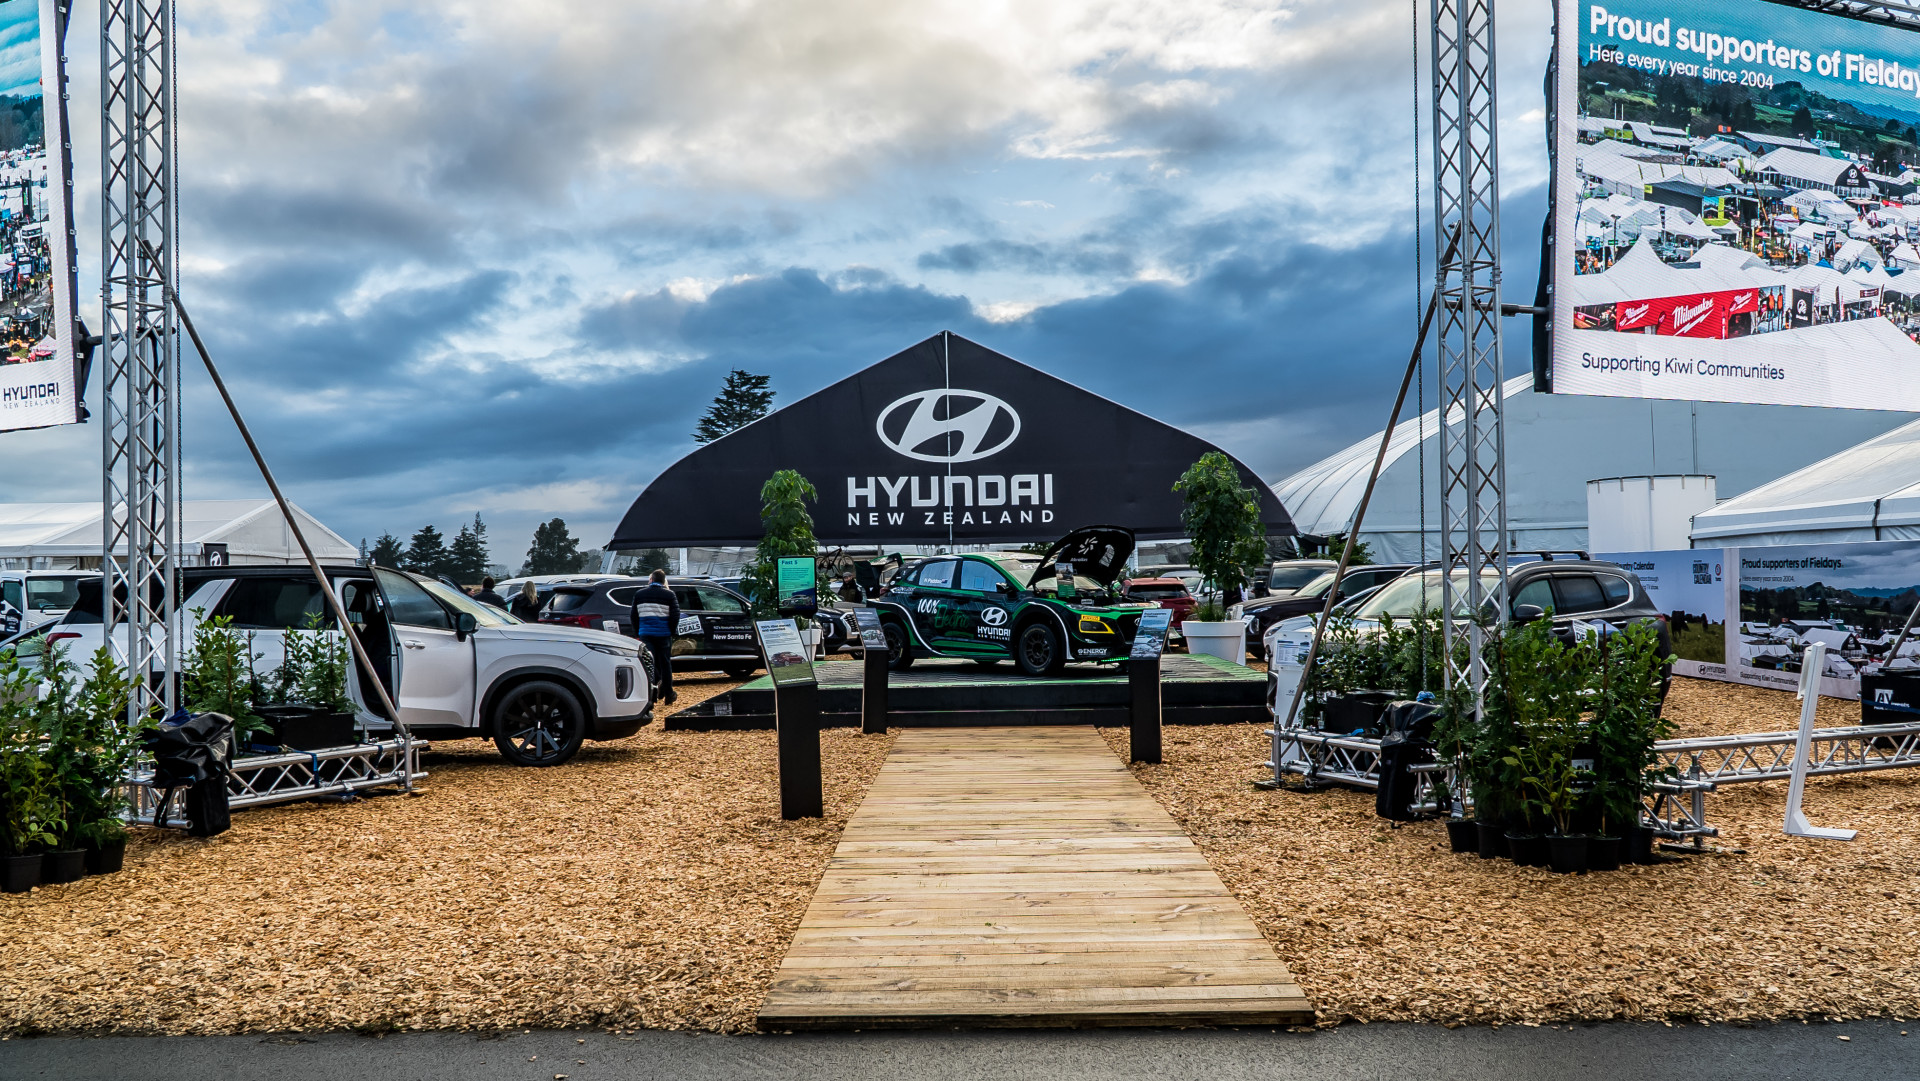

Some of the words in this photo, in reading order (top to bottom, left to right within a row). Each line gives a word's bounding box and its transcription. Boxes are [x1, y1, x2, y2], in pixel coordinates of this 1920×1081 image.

[1590, 5, 1670, 47] Proud
[1676, 27, 1812, 73] supporters
[1816, 50, 1841, 77] of
[1589, 43, 1625, 64] Here
[1627, 53, 1667, 75] every
[1669, 60, 1700, 77] year
[1702, 63, 1737, 84] since
[1740, 69, 1774, 90] 2004
[1672, 297, 1714, 329] Milwaukee
[1581, 352, 1661, 376] Supporting
[1665, 357, 1694, 375] Kiwi
[1697, 359, 1785, 380] Communities
[3, 382, 59, 401] HYUNDAI
[3, 402, 20, 410] NEW
[24, 397, 60, 408] ZEALAND
[847, 474, 1053, 508] HYUNDAI
[848, 513, 905, 526] NEW
[924, 509, 1054, 525] ZEALAND
[1633, 561, 1655, 571] Calendar
[1741, 558, 1761, 569] Proud
[1762, 558, 1800, 571] supporters
[1800, 557, 1809, 569] of
[918, 598, 940, 614] 100%
[678, 623, 701, 634] DEALS
[977, 626, 1011, 637] HYUNDAI
[1740, 671, 1761, 682] Supporting
[1771, 675, 1798, 687] Communities
